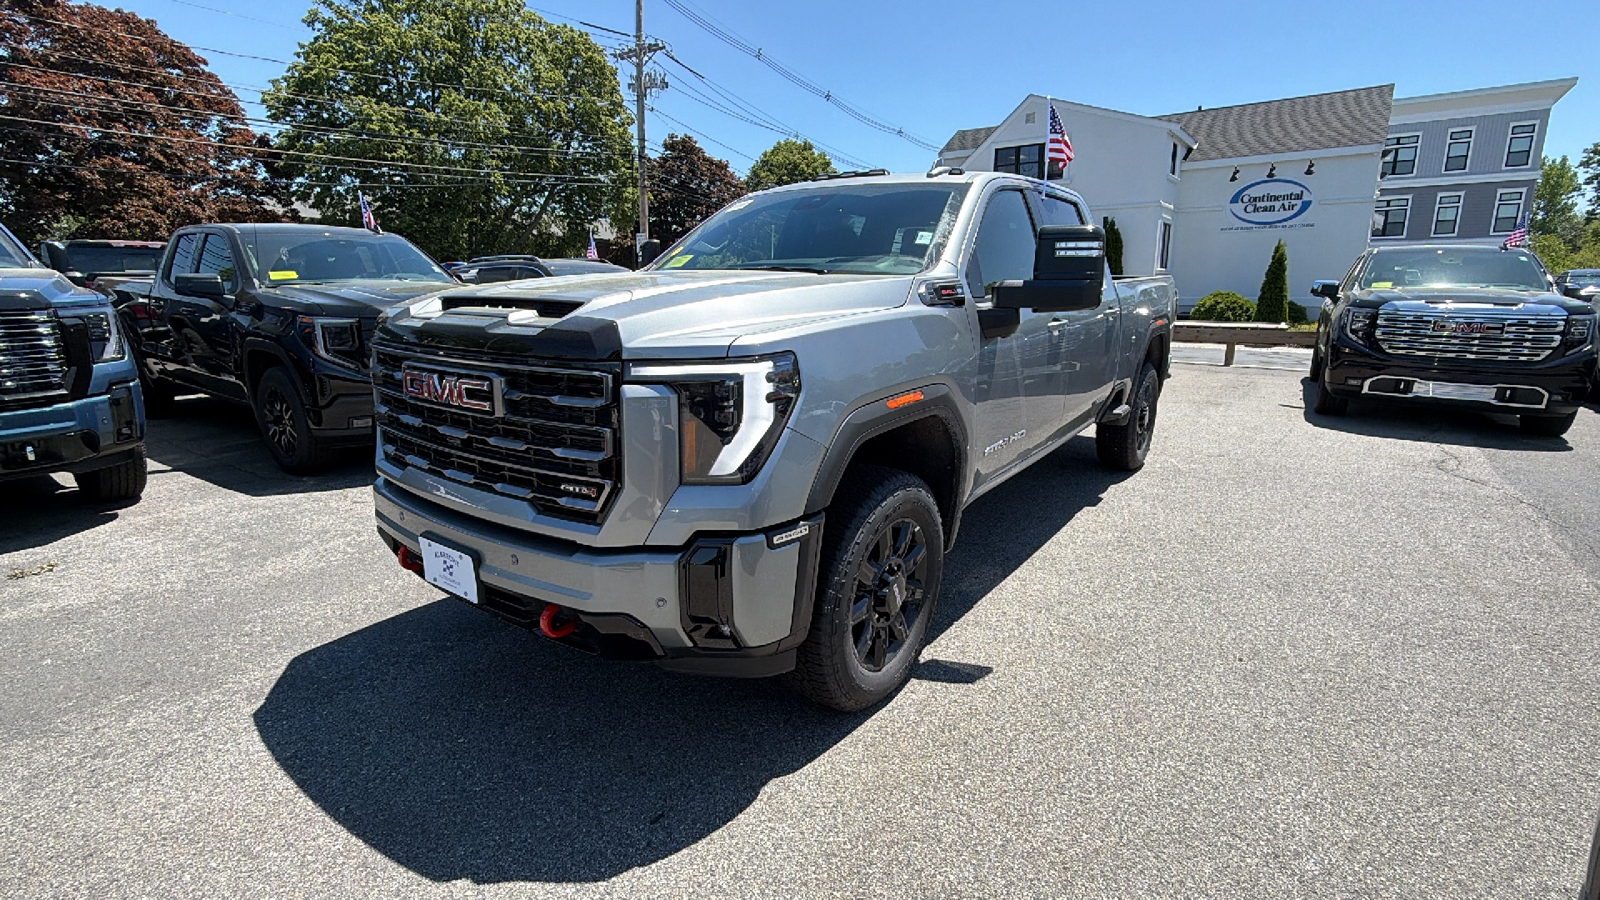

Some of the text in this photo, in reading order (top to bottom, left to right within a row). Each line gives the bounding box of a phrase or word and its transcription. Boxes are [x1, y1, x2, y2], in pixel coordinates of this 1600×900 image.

[1240, 190, 1304, 204] Continental
[1243, 201, 1298, 214] Clean Air
[1435, 321, 1503, 333] GMC
[403, 370, 492, 411] GMC
